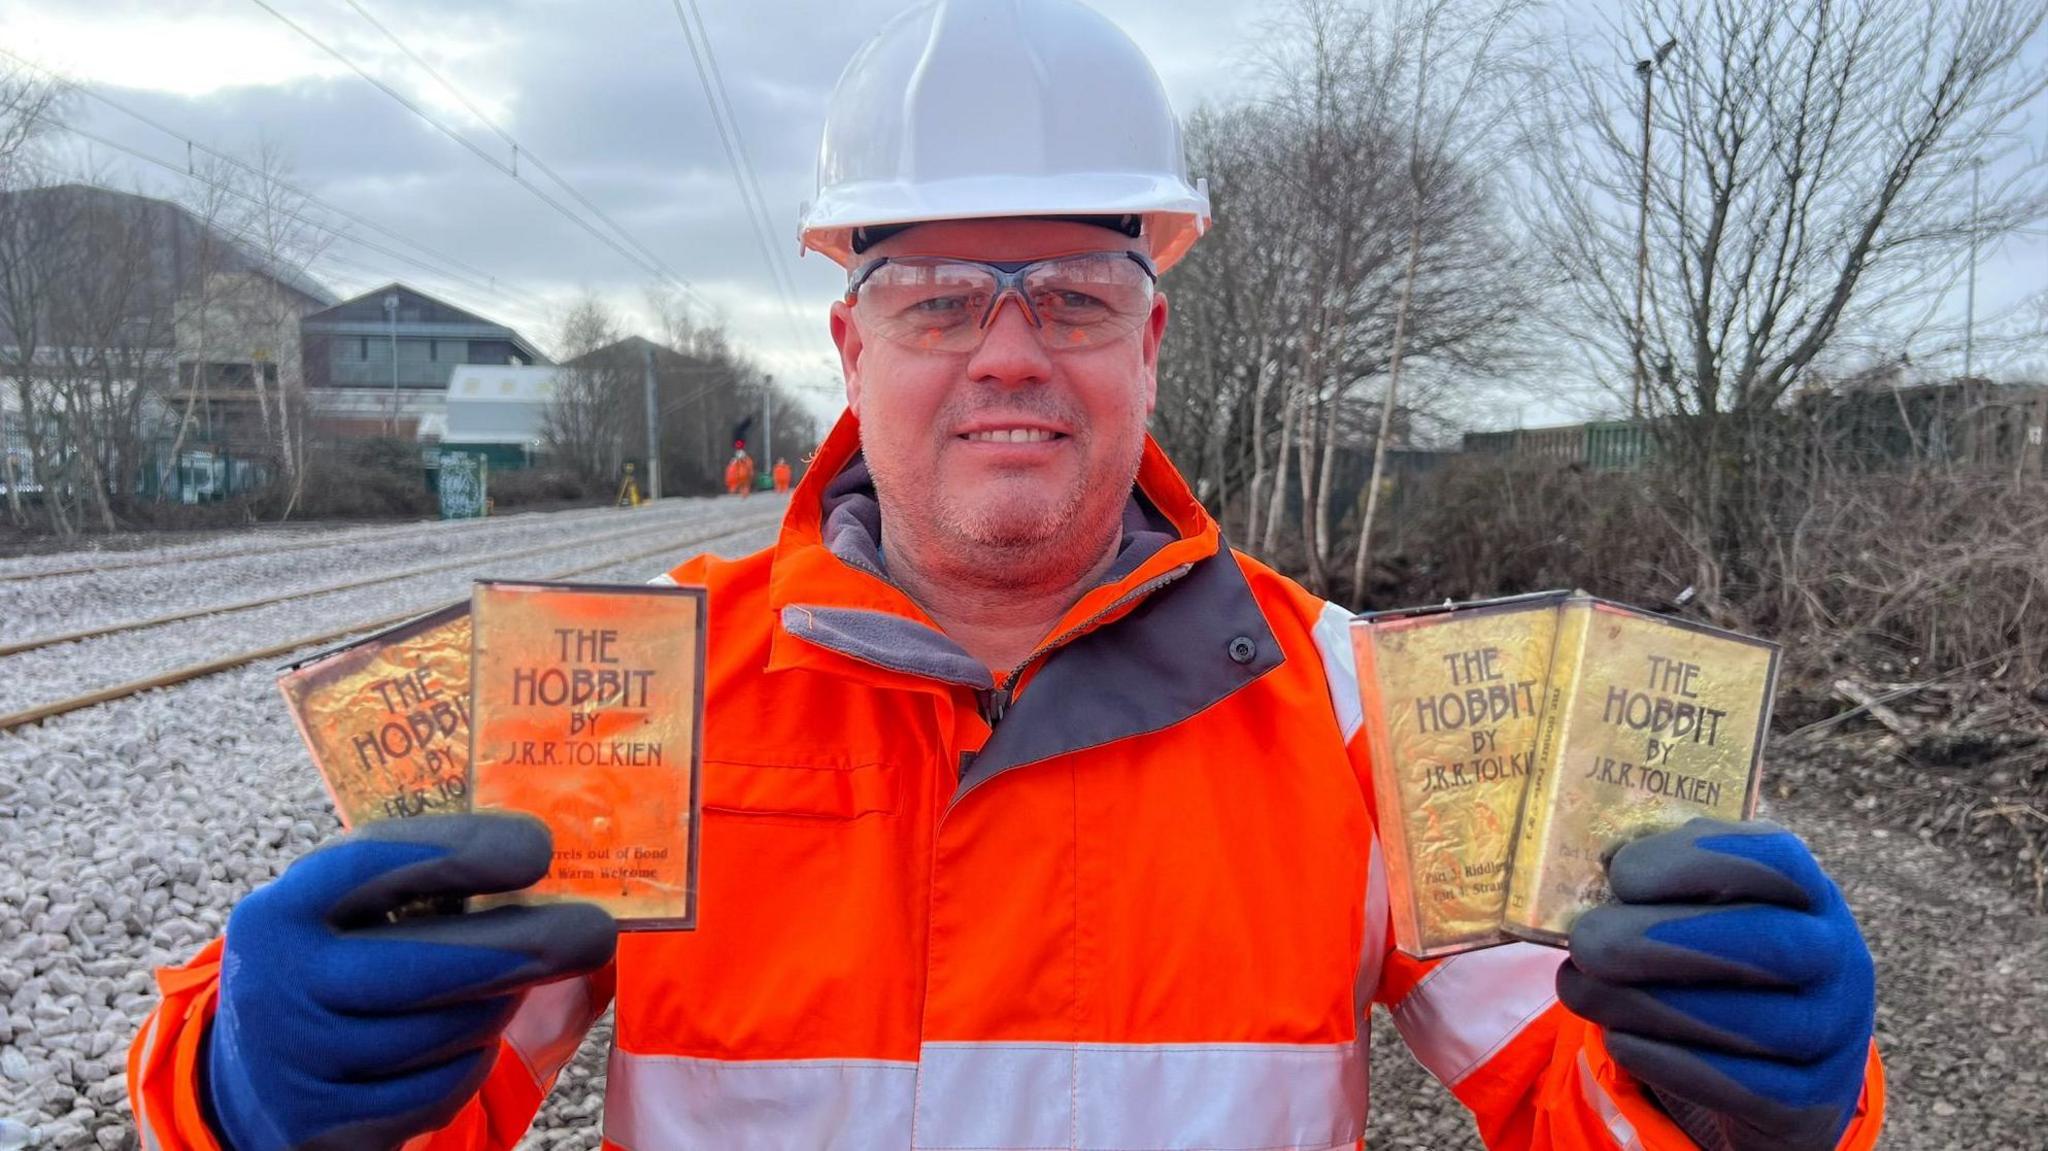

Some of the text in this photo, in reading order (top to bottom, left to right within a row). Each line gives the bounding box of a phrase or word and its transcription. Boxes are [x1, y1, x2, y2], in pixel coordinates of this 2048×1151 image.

[554, 628, 619, 663] THE
[1443, 647, 1503, 686] THE
[1648, 655, 1701, 699] THE
[371, 667, 444, 713] THE
[512, 668, 656, 707] HOBBIT
[571, 712, 600, 736] BY
[1415, 679, 1537, 734] HOBBIT
[1603, 686, 1728, 746] HOBBIT
[352, 692, 469, 771] HOBBI
[1472, 728, 1498, 754] BY
[426, 746, 455, 774] BY
[1647, 738, 1675, 765] BY
[587, 848, 609, 860] out
[616, 847, 629, 860] of
[634, 847, 668, 860] Bond
[558, 867, 594, 879] Warm
[601, 866, 658, 880] Welcome
